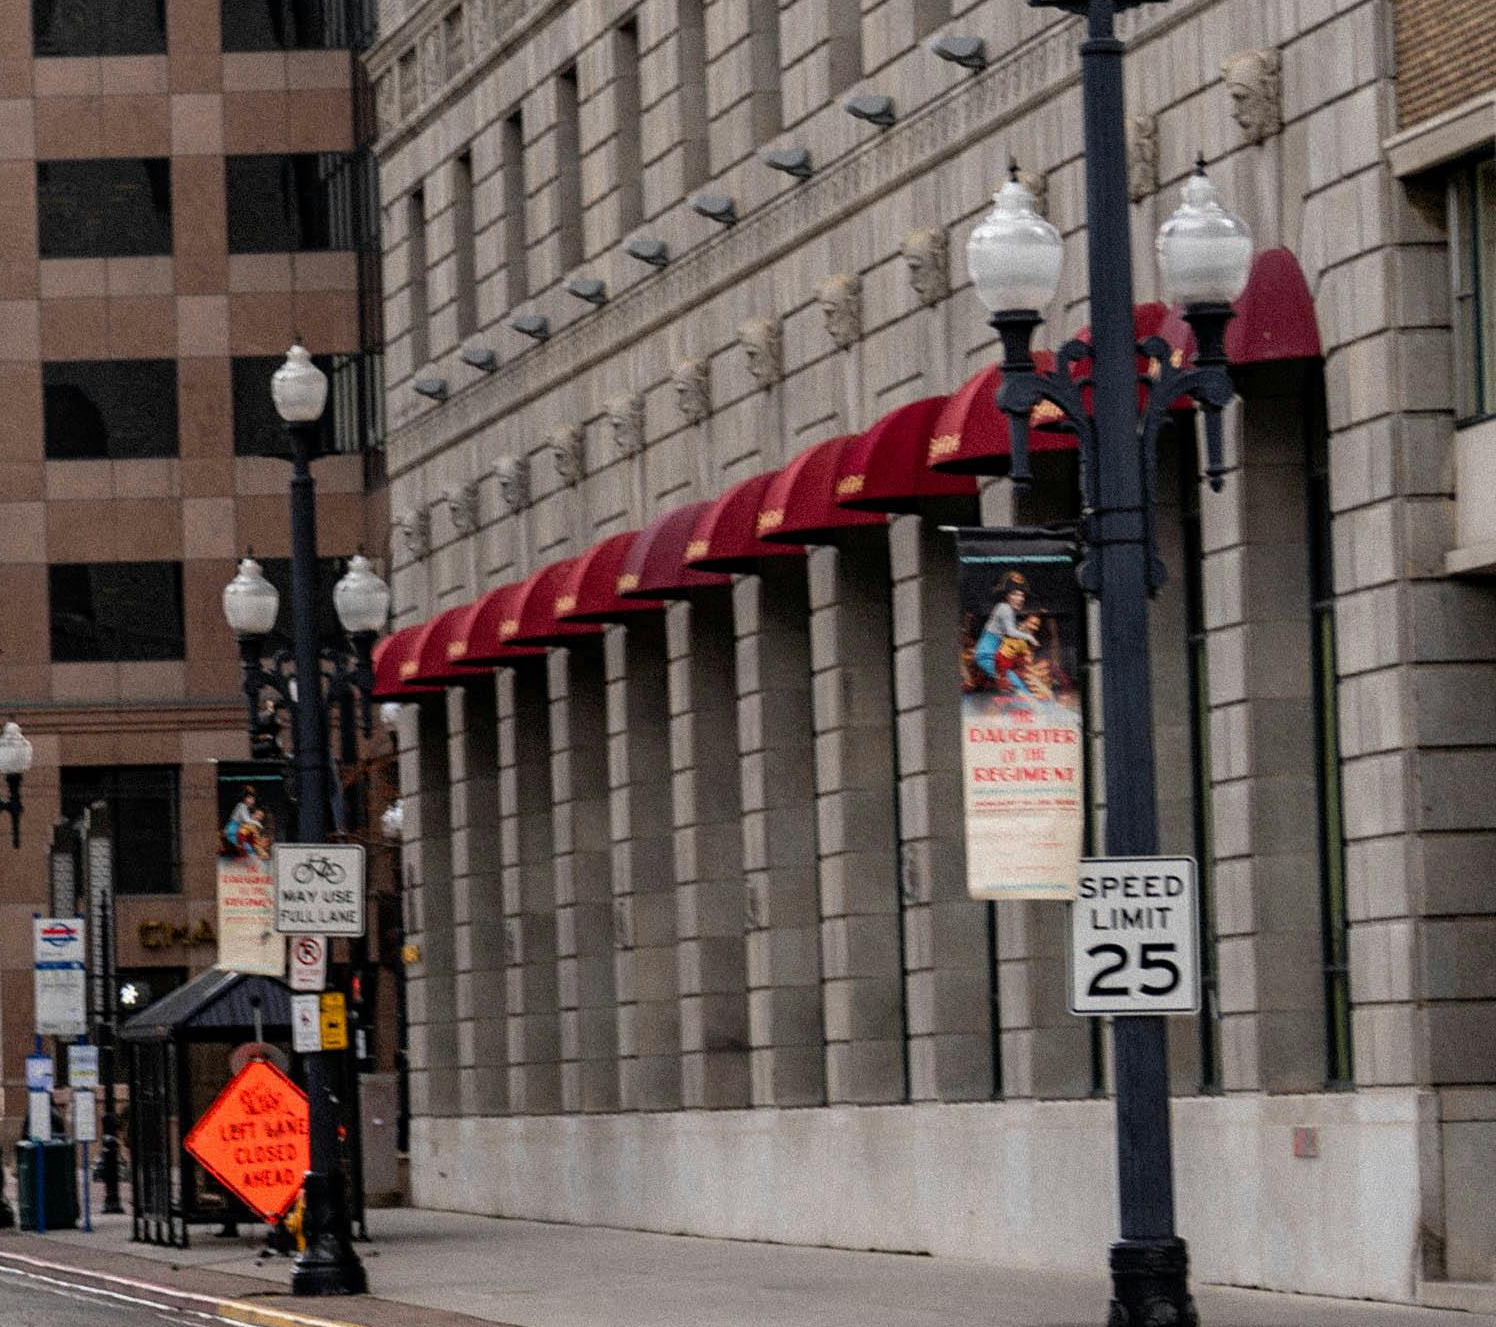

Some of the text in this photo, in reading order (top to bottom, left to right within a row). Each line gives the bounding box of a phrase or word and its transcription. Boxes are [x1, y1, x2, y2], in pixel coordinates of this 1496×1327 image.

[968, 728, 1077, 744] DAUGHTER
[973, 767, 1076, 783] REGIMENT
[1079, 876, 1185, 899] SPEED
[283, 890, 318, 904] MAY
[323, 890, 355, 904] USE
[281, 910, 316, 923] FULL
[318, 910, 356, 923] LANE
[1091, 907, 1173, 930] LIMIT
[1086, 943, 1180, 996] 25
[234, 1143, 297, 1164] CLOSED
